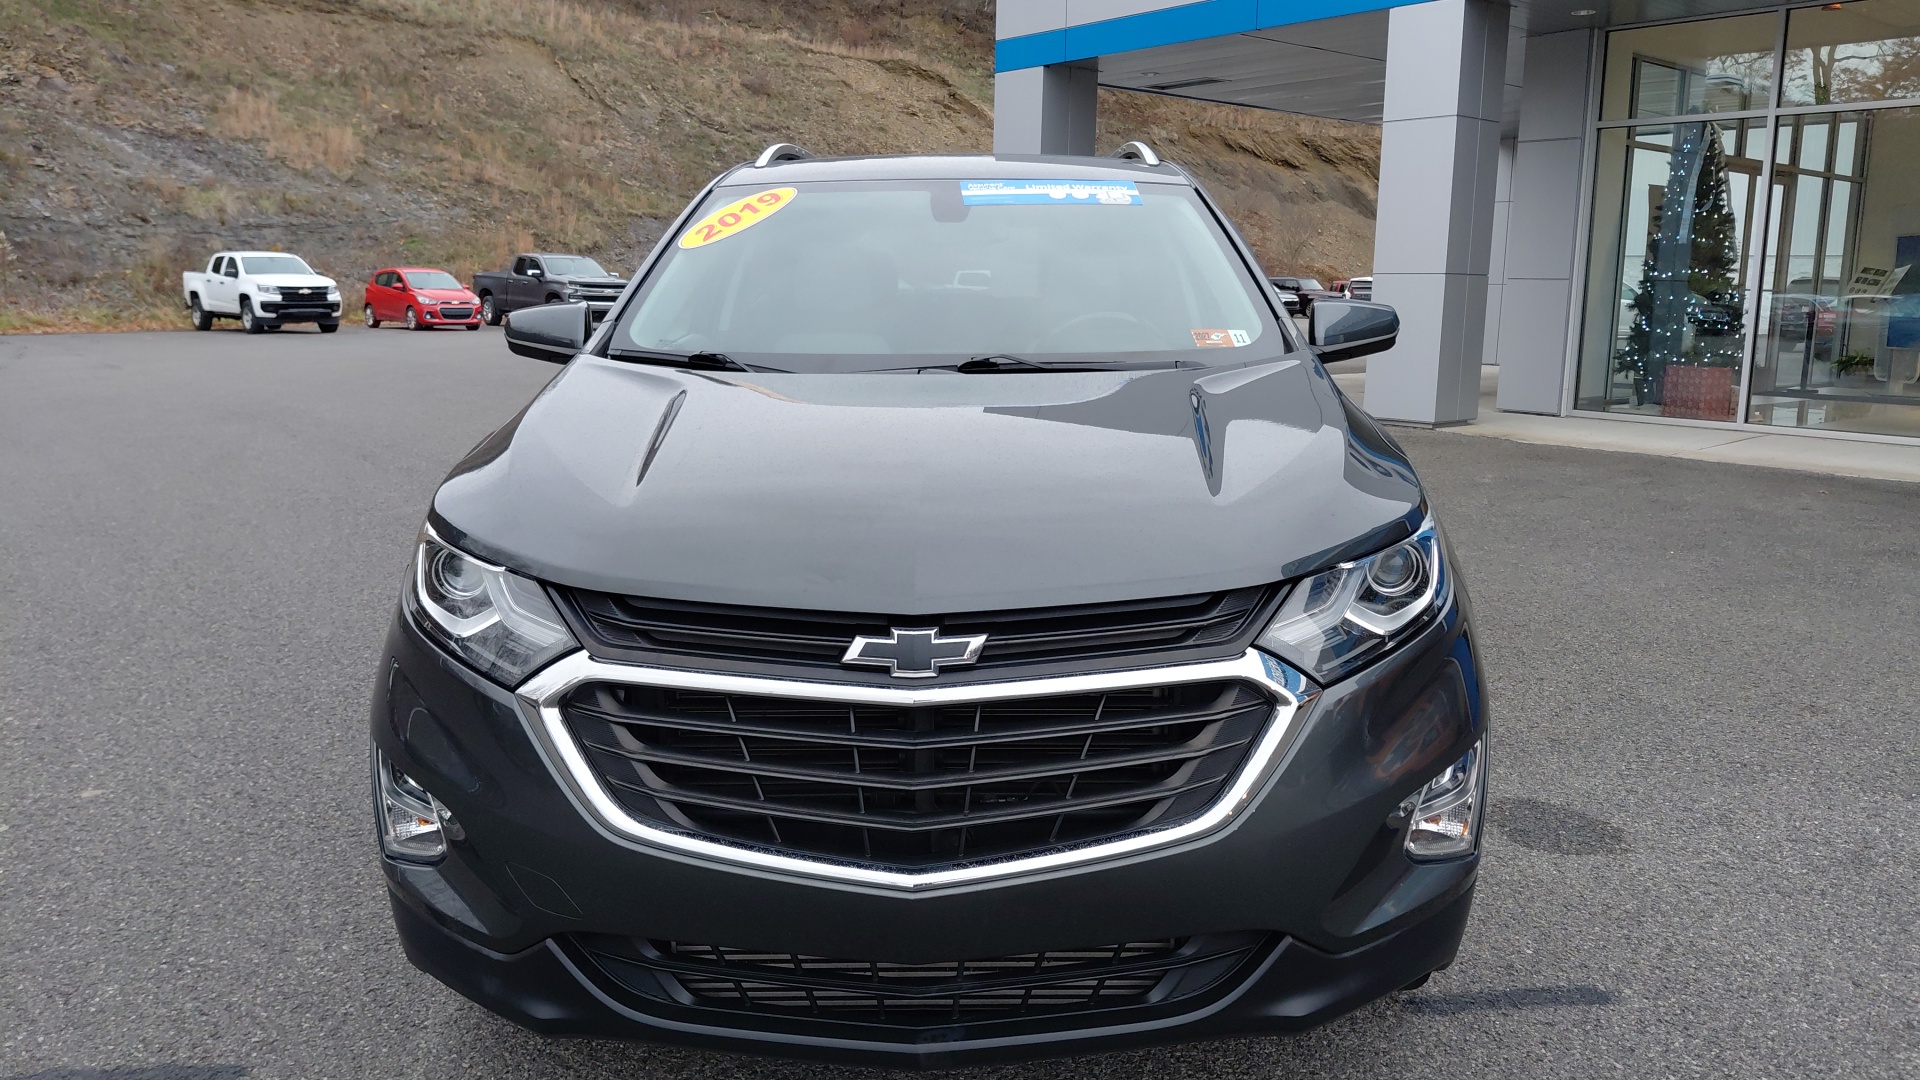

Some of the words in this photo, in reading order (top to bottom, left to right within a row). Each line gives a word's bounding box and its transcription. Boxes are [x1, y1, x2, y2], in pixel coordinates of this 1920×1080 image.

[1071, 184, 1128, 192] Warranty
[695, 193, 782, 242] 2019
[1233, 333, 1247, 344] 11
